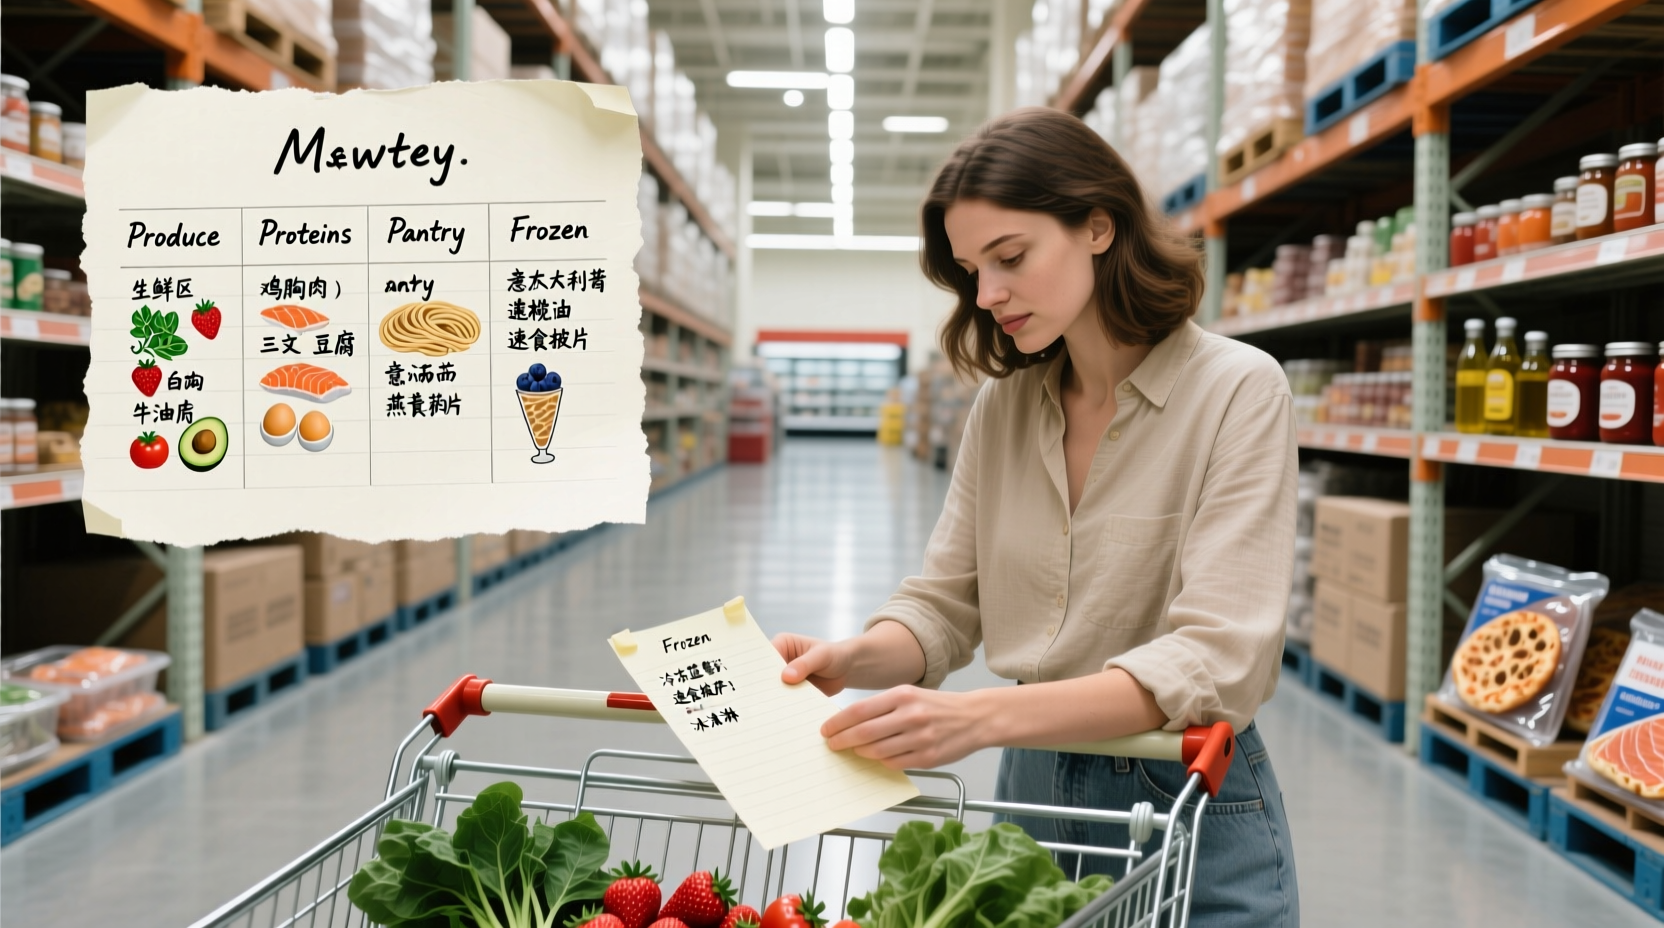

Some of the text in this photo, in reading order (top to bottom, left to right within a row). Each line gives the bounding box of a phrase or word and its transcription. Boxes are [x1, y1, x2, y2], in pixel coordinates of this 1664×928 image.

[127, 221, 221, 249] Produce
[259, 218, 352, 246] Proteins
[387, 216, 466, 255] Pantry
[510, 214, 589, 243] Frozen
[132, 276, 194, 302] 生鲜区
[313, 330, 355, 357] 豆腐
[662, 634, 712, 654] Frozen
